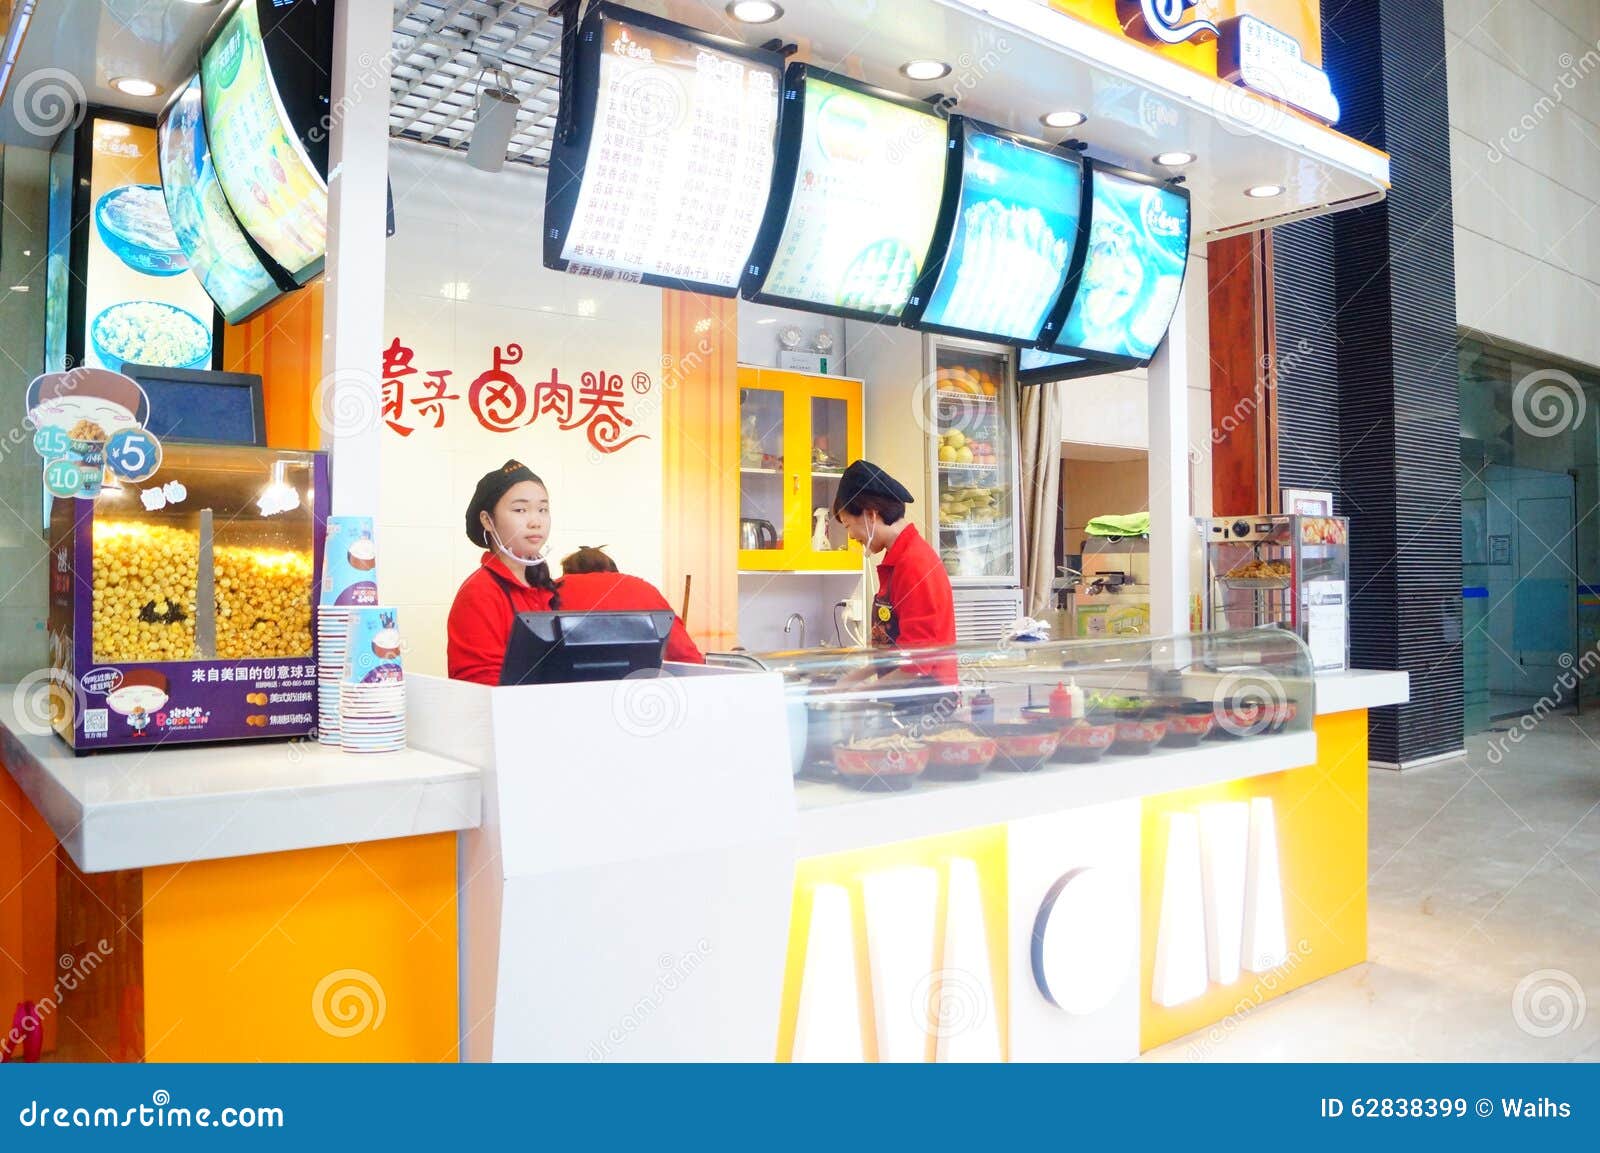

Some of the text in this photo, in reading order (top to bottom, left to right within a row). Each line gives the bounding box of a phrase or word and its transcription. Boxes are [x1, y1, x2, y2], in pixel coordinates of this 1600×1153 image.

[617, 270, 641, 284] 10元
[111, 435, 146, 472] ¥5
[192, 666, 317, 683] 来自美国的创意球豆
